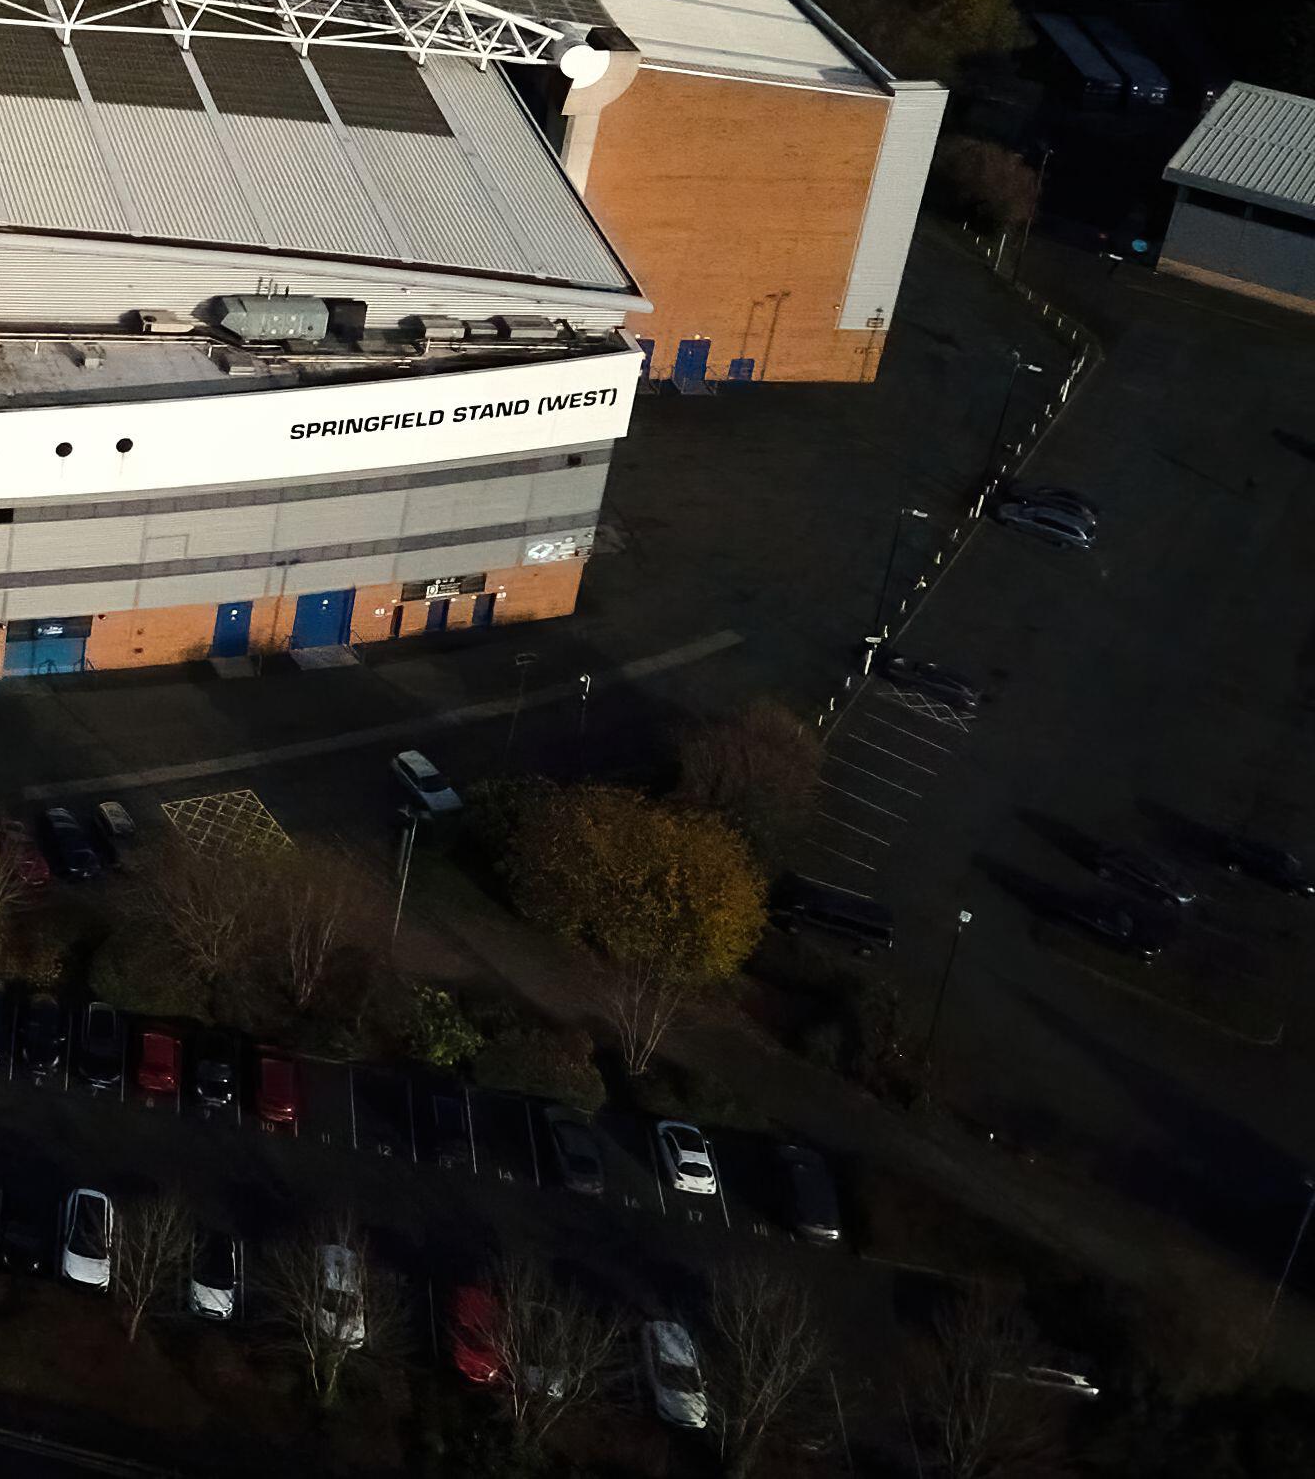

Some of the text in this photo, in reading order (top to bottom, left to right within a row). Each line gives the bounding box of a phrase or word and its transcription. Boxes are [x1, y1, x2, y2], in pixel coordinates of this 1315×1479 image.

[290, 388, 618, 440] SPRINGFIELD STAND (WEST)
